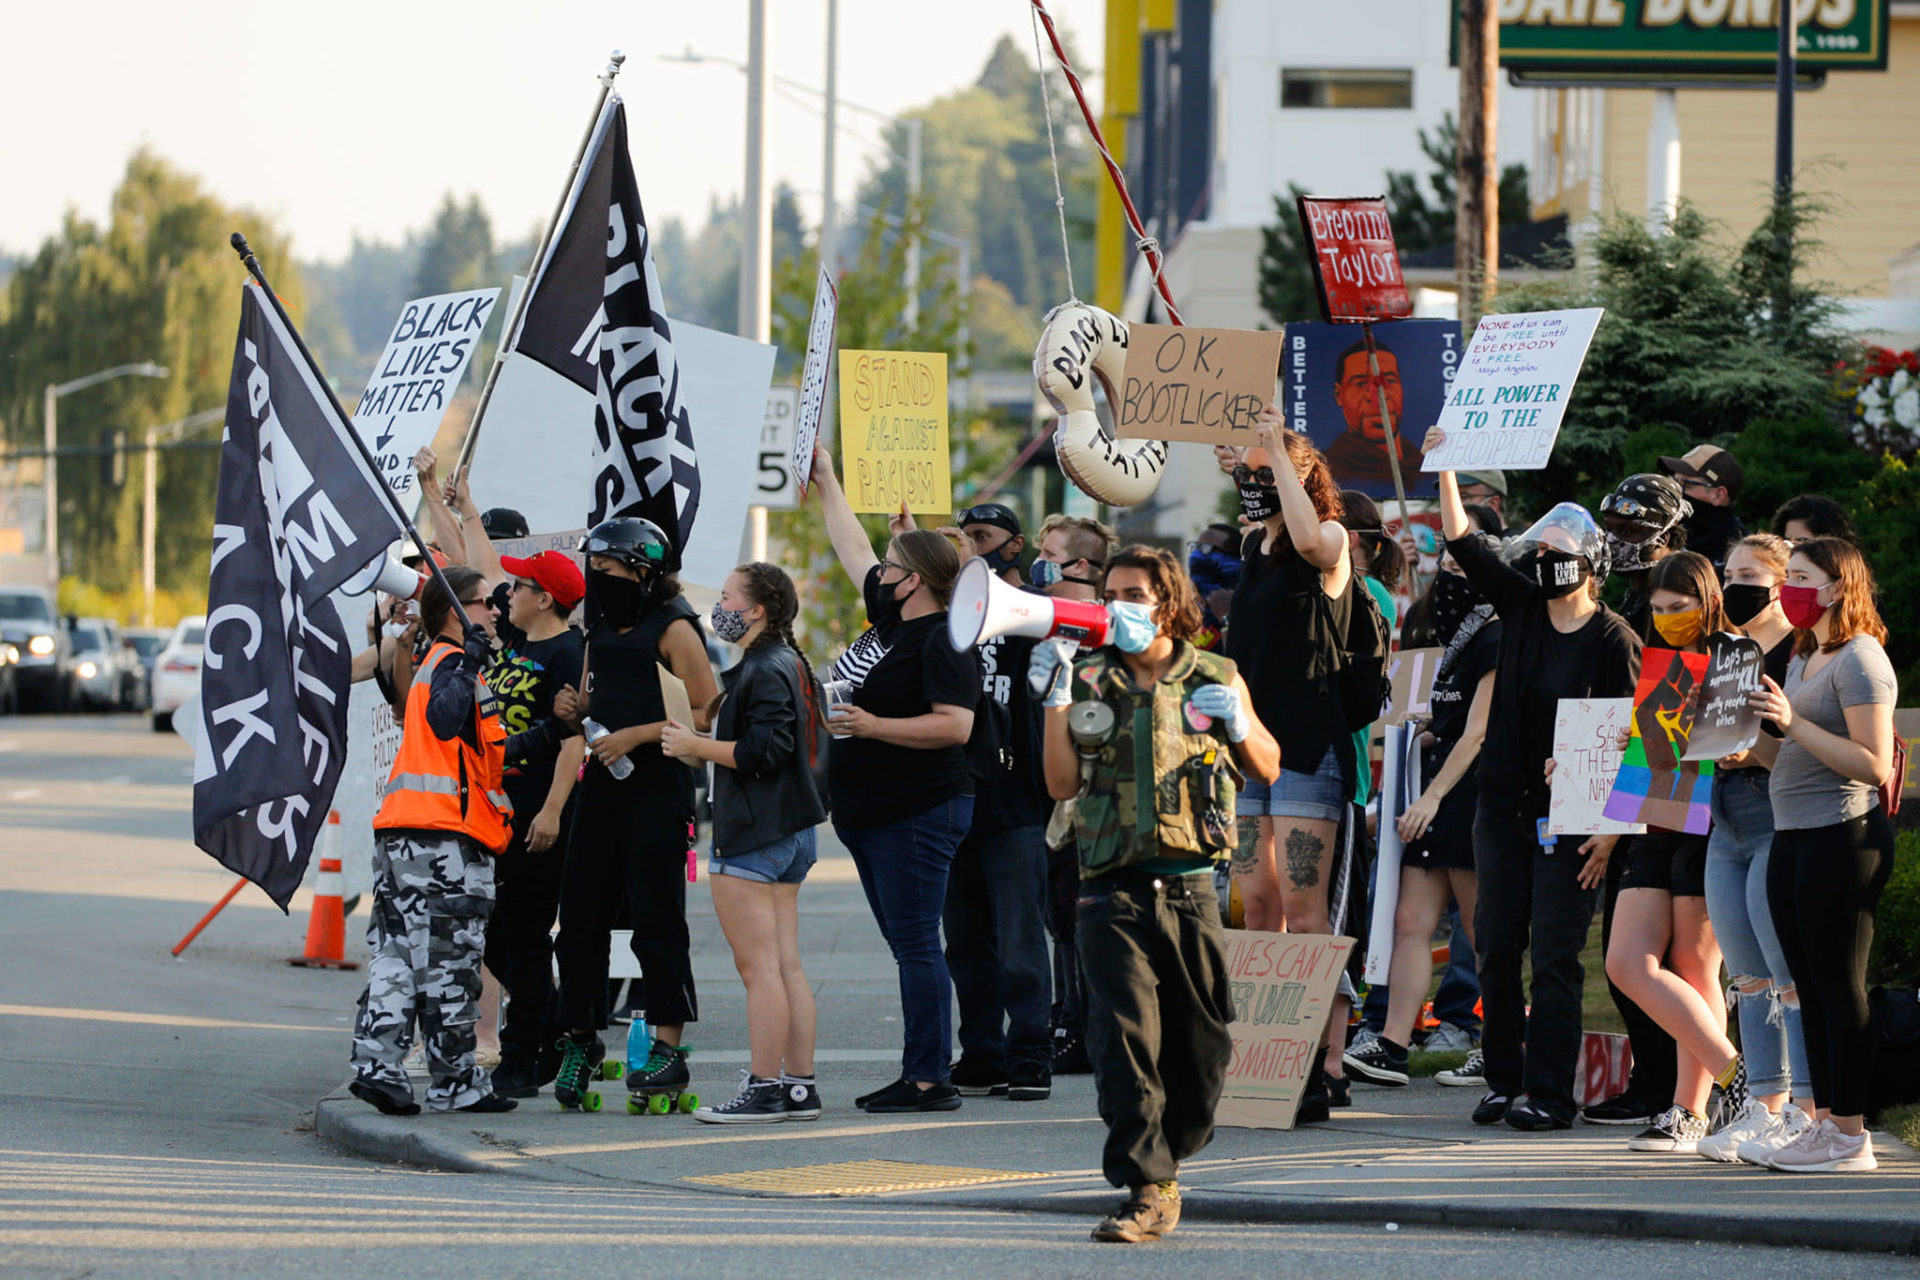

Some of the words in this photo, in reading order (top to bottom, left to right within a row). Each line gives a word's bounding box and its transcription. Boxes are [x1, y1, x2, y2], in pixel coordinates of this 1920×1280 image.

[1321, 247, 1395, 287] Taylor
[393, 297, 494, 343] BLACK
[1479, 320, 1511, 331] NONE
[1512, 317, 1527, 329] of
[1543, 319, 1562, 328] can
[1483, 332, 1498, 342] be
[1504, 330, 1534, 340] FREE
[1541, 326, 1568, 338] until
[381, 338, 471, 379] LIVES
[1053, 316, 1103, 390] BLACK
[1472, 354, 1481, 365] is
[1473, 340, 1557, 354] EVERYBODY
[354, 379, 445, 417] MATTER
[854, 354, 936, 412] STAND
[1293, 336, 1307, 433] BETTER
[1449, 387, 1485, 406] ALL
[1493, 384, 1560, 404] POWER
[1121, 377, 1264, 431] BOOTLICKER
[1463, 410, 1489, 430] TO
[1500, 408, 1542, 428] THE
[866, 415, 938, 452] AGAINST
[1424, 429, 1554, 467] PEOPLE
[857, 457, 936, 507] RACISM
[1554, 560, 1579, 570] BLACK
[1555, 567, 1579, 578] LIVES
[1555, 575, 1579, 586] MATTER
[1737, 662, 1764, 692] KILL
[1725, 694, 1747, 710] people
[1574, 749, 1625, 774] THEI
[1588, 778, 1616, 802] NAM
[1226, 939, 1276, 978] IVES
[1276, 941, 1348, 981] CAN'T
[1254, 982, 1307, 1026] UNTIL
[1236, 1038, 1316, 1080] MATTER!
